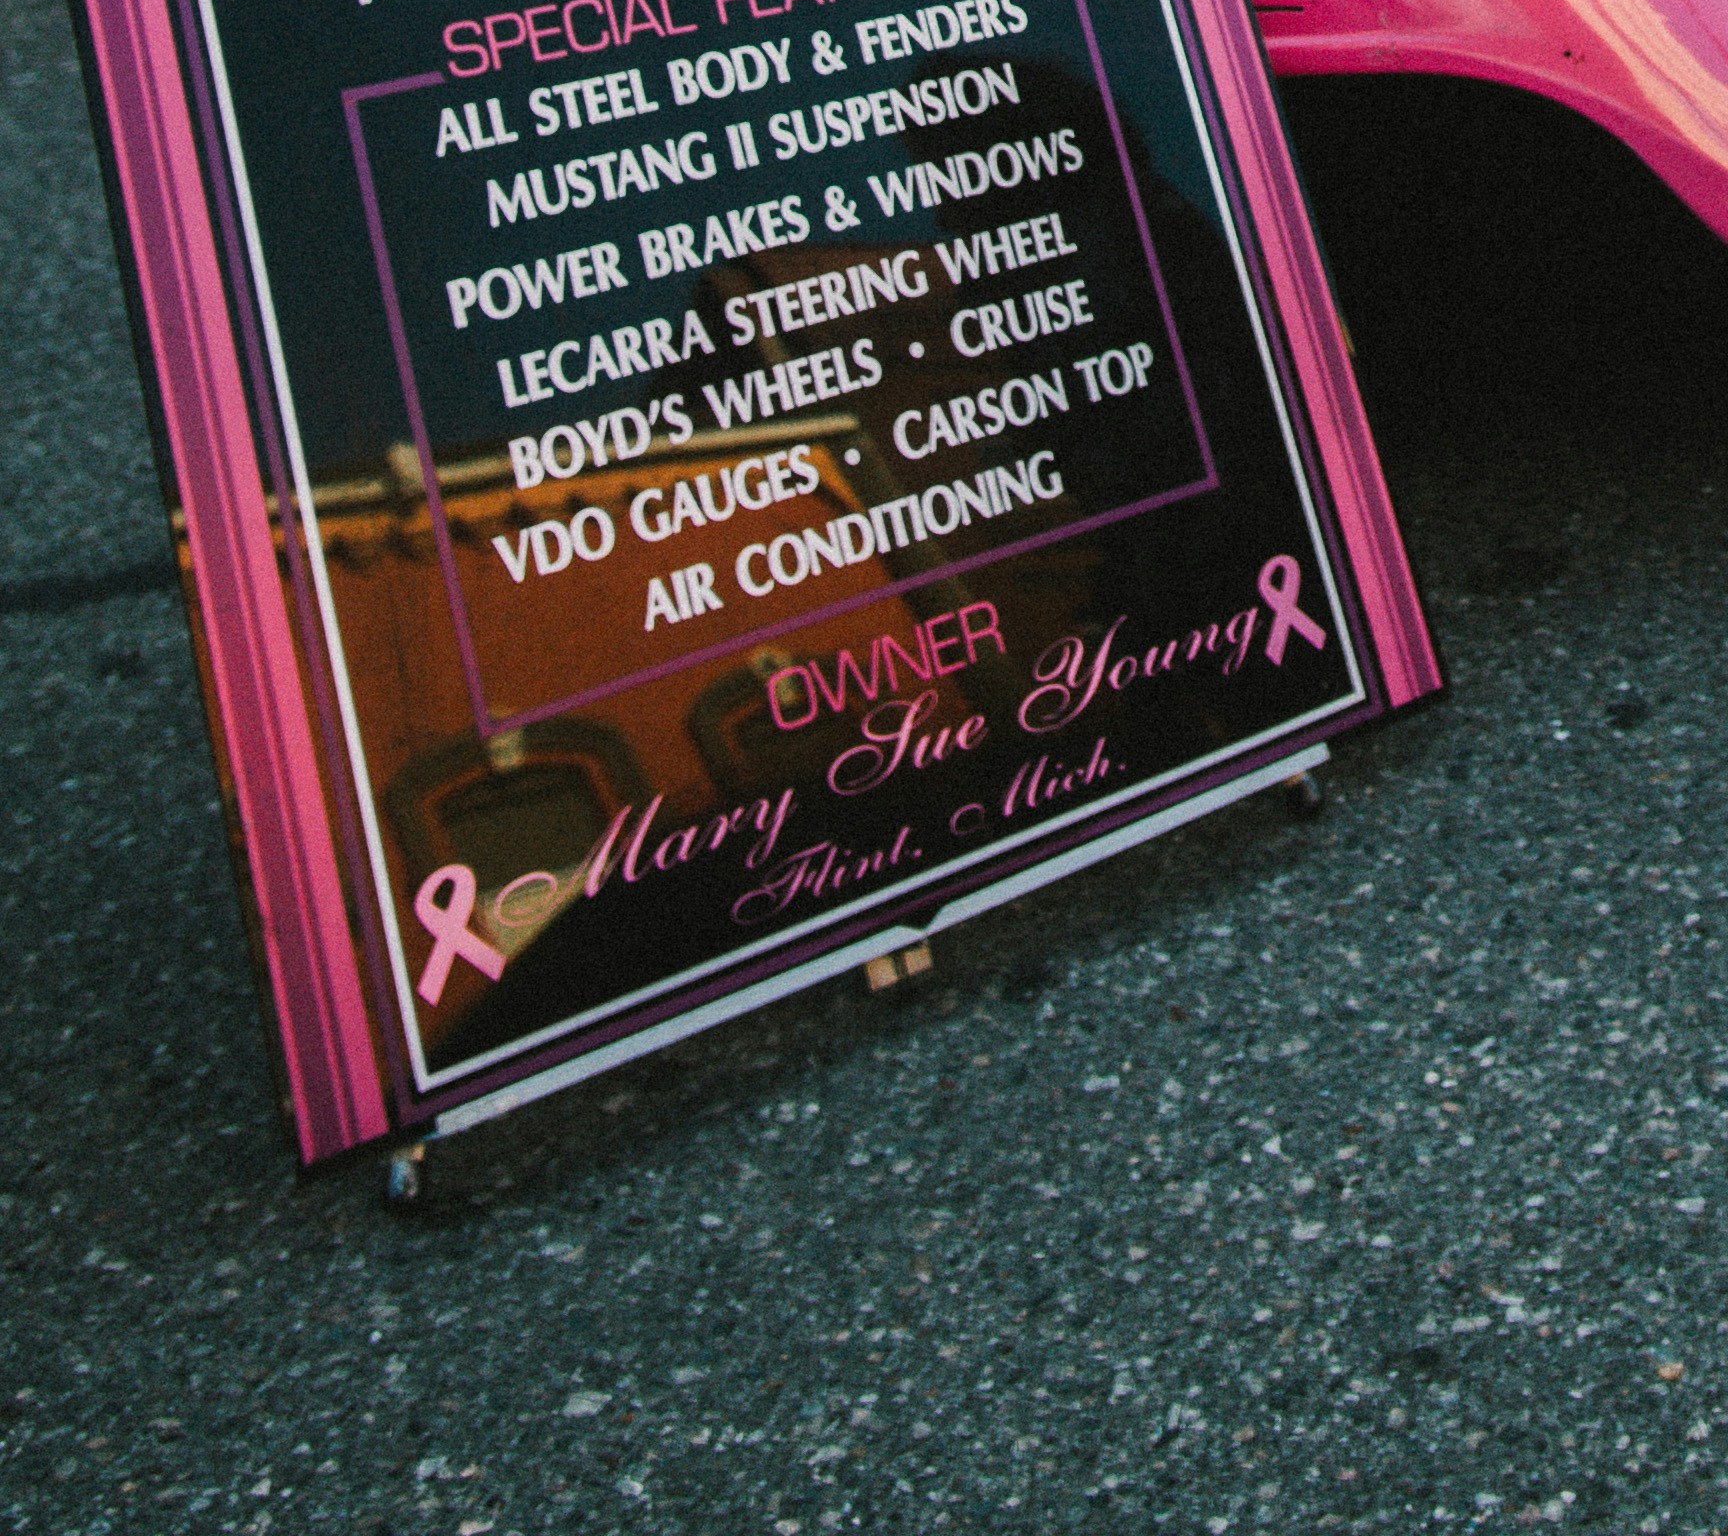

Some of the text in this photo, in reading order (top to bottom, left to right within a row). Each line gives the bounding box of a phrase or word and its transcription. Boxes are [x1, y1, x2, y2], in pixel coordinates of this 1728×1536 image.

[436, 99, 518, 157] ALL
[529, 69, 658, 135] STEEL
[667, 38, 790, 105] BODY
[812, 31, 846, 75] &
[487, 132, 716, 227] MUSTANG
[768, 64, 1019, 160] SUSPENSION
[446, 129, 1082, 328] POWER BRAKES & WINDOWS
[497, 214, 1077, 407] LECARRA STEERING WHEEL
[493, 343, 1152, 582] VDO GAUGES CARSON TOP
[510, 280, 1093, 490] BOYD'S WHEELS CRUISE
[645, 452, 1062, 631] AIR CONDITIONING
[768, 600, 1006, 730] OWNER
[494, 606, 1262, 928] Mary Sue Young
